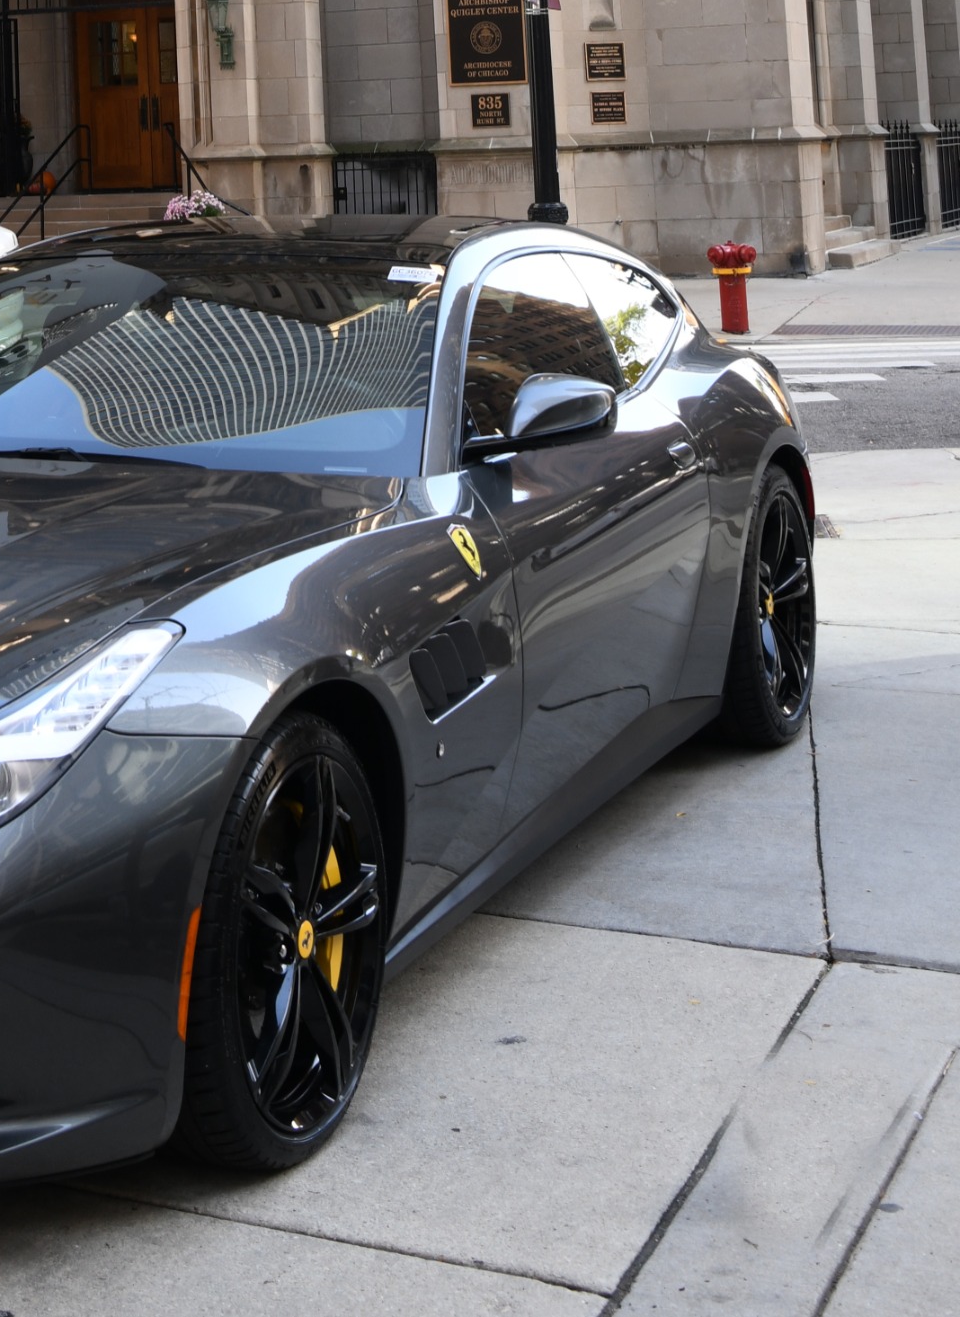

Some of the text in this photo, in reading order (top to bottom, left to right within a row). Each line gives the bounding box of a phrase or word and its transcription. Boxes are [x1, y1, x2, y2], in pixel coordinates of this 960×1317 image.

[450, 5, 519, 18] QUIGLEY CENTER
[463, 60, 512, 70] ARCHDIOCESE
[467, 69, 509, 78] OF CHICAGO
[478, 96, 503, 110] 835
[479, 110, 502, 118] NORTH
